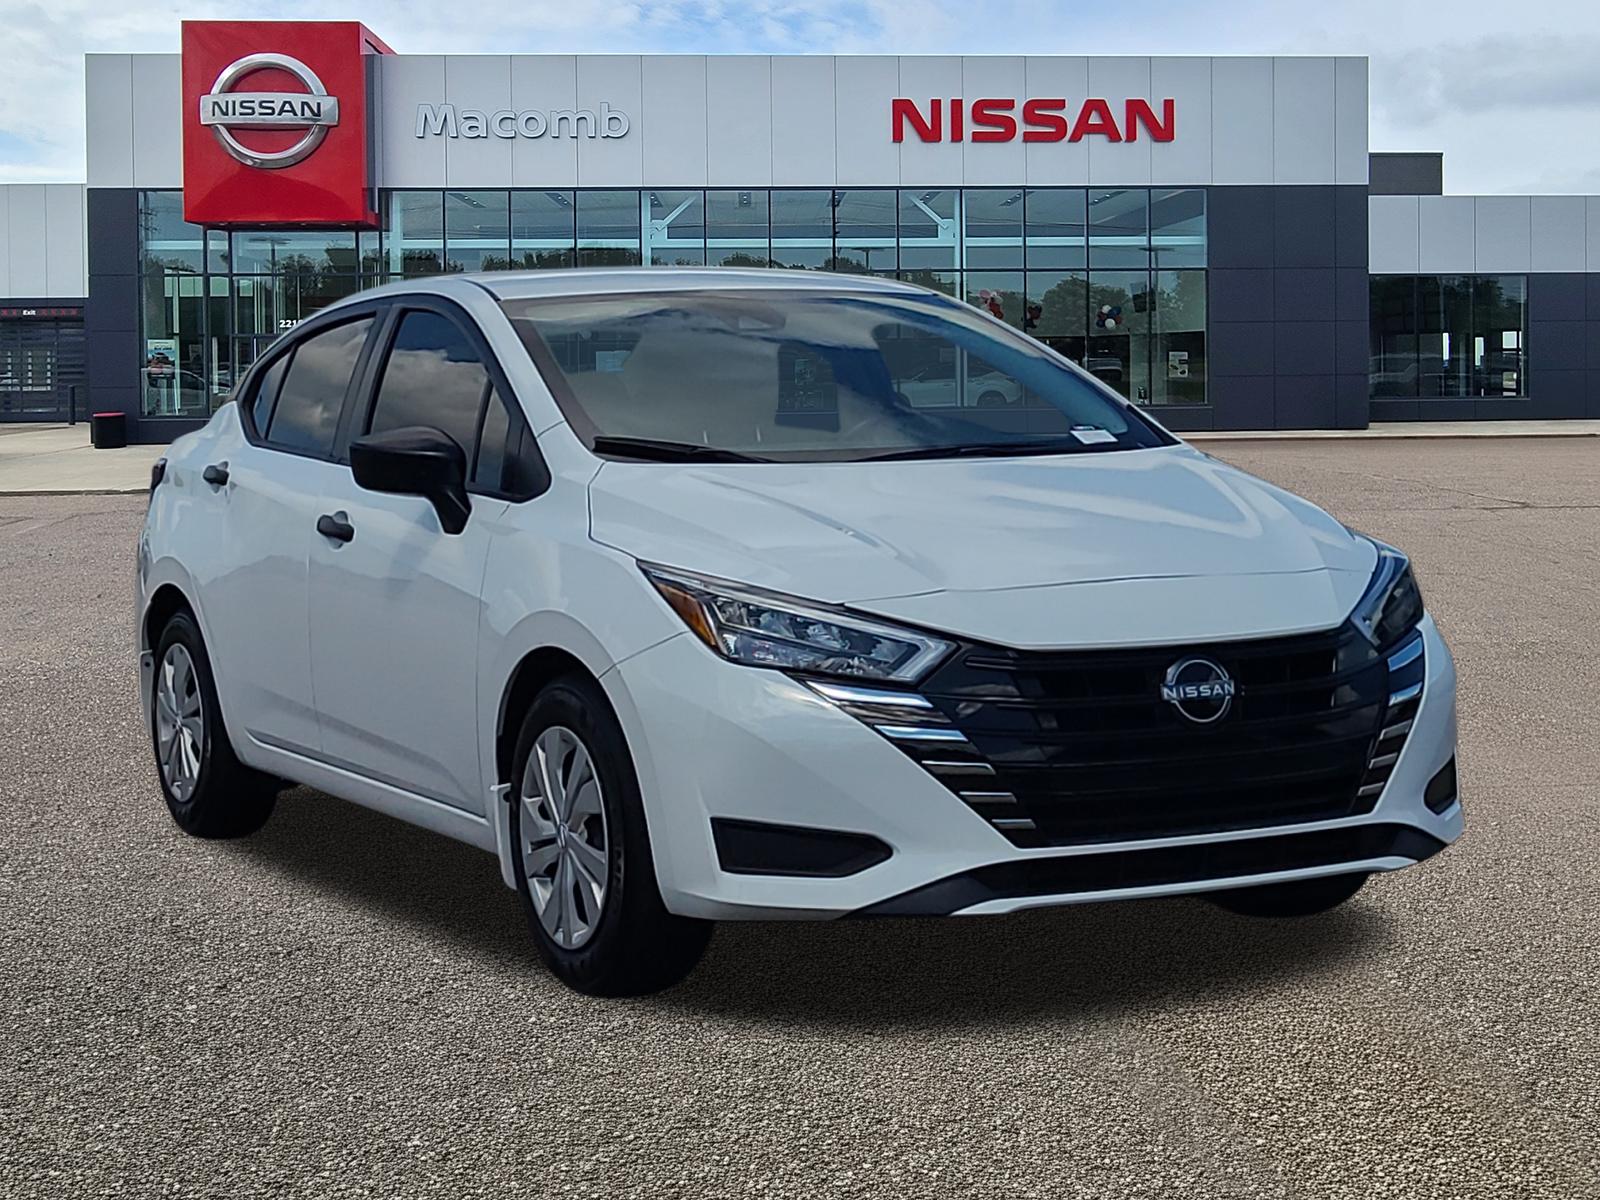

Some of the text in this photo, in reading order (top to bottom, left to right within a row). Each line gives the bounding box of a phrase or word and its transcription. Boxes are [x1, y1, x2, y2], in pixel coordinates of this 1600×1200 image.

[212, 100, 322, 117] NISSAN
[415, 101, 630, 138] Macomb
[892, 98, 1175, 142] NISSAN
[1162, 682, 1235, 700] NISSAN
